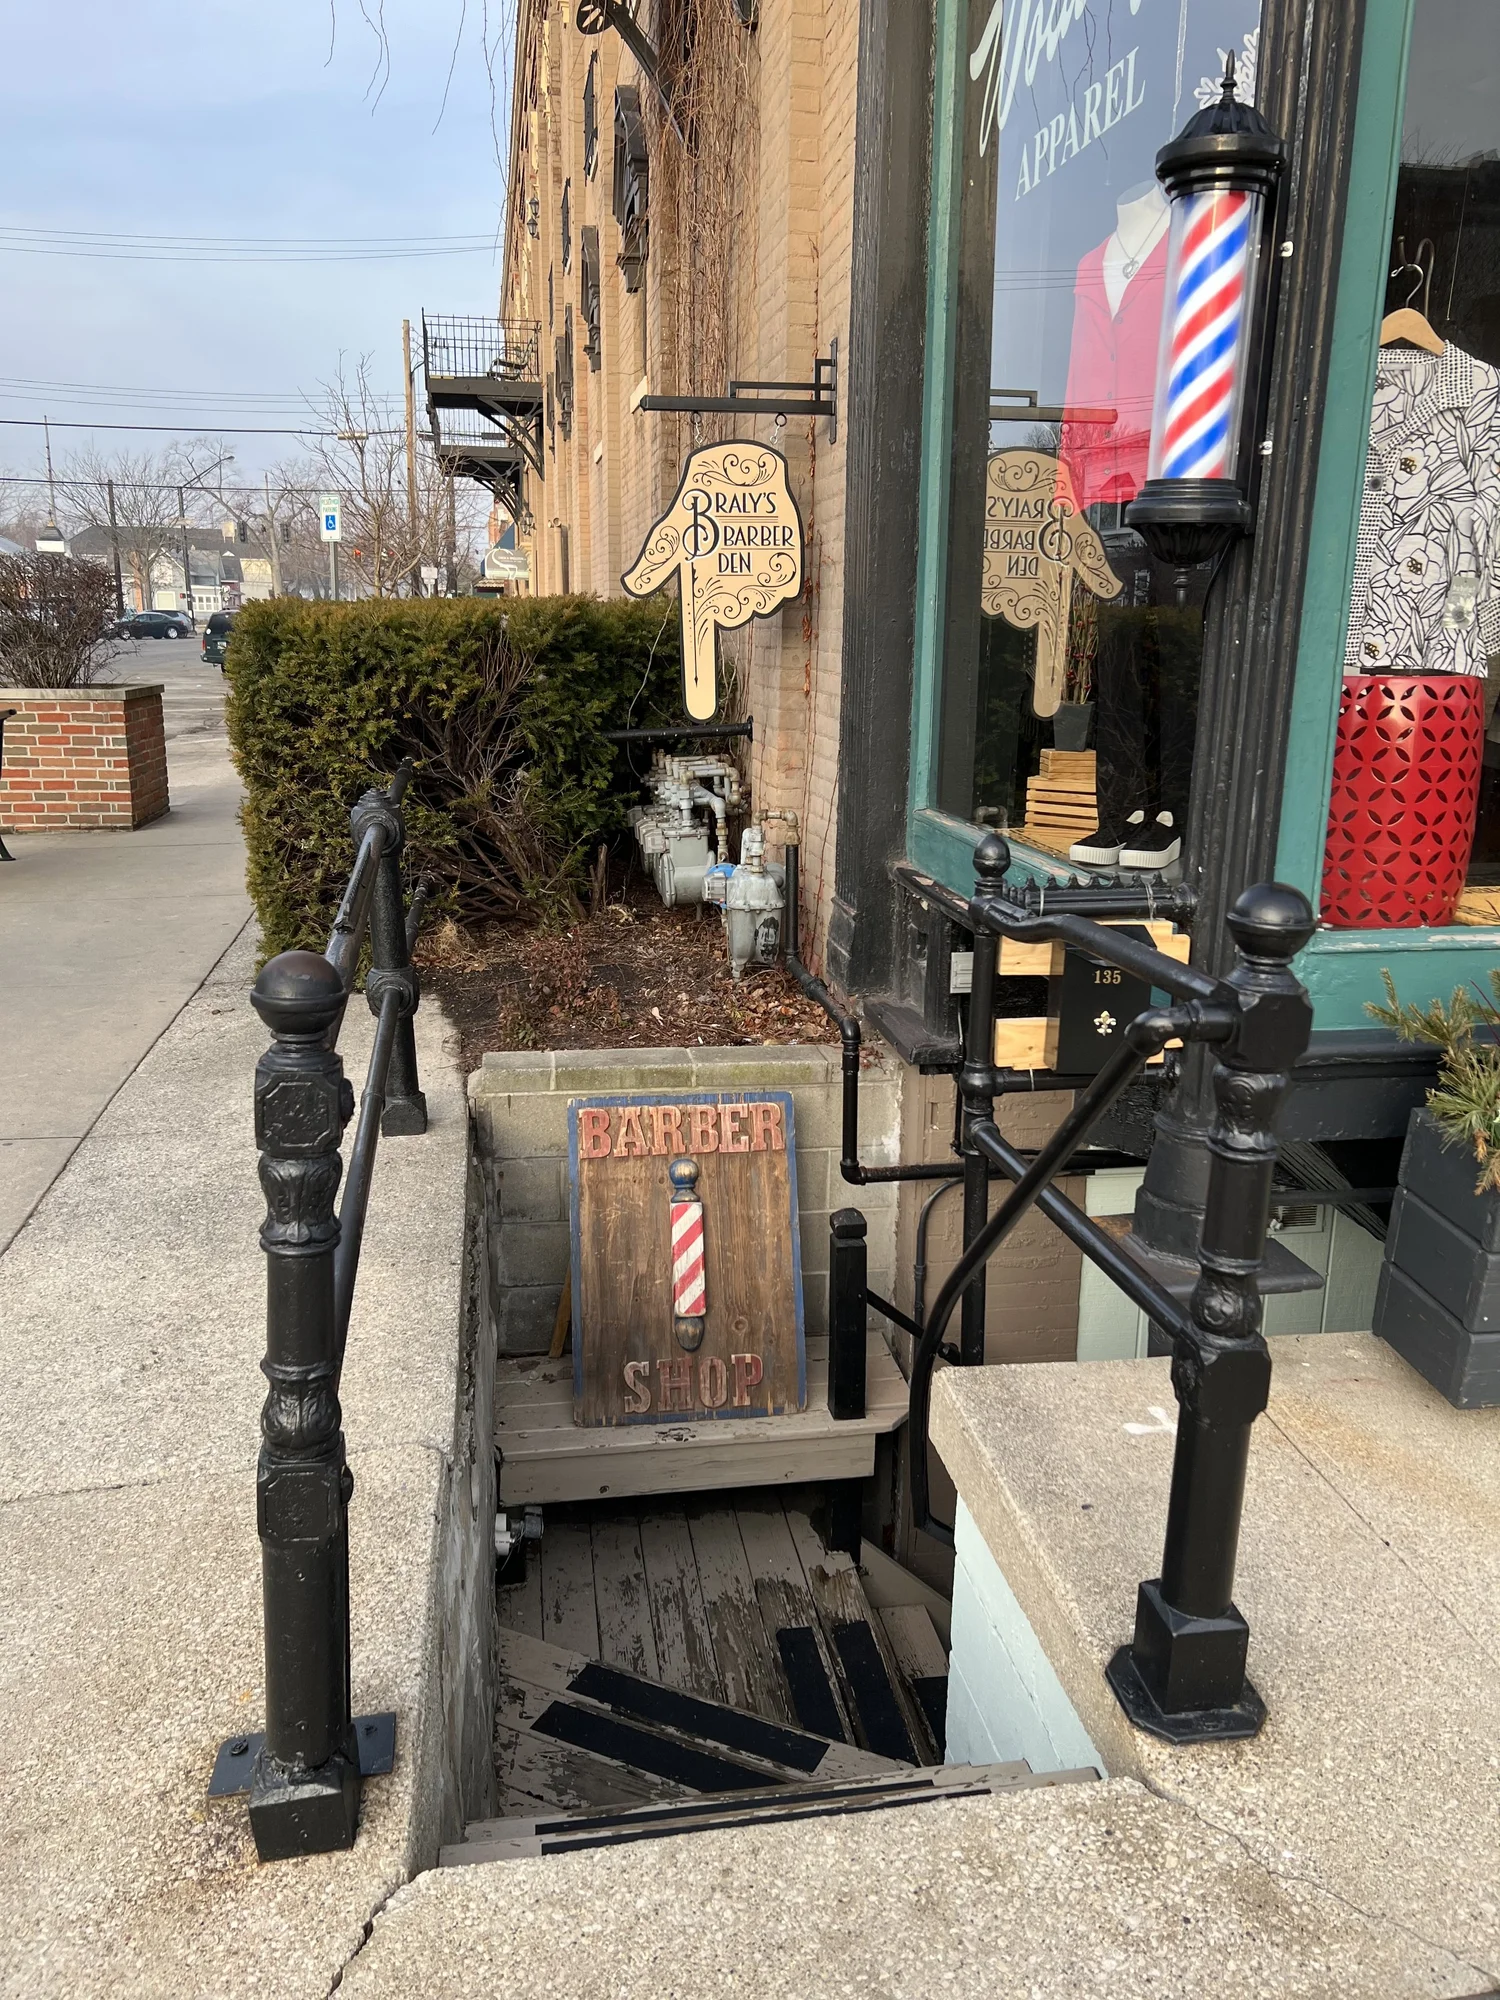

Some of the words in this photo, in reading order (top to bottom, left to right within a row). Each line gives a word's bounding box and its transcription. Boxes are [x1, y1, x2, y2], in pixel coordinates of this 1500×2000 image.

[1014, 46, 1146, 202] APPAREL
[723, 525, 796, 547] BARBER
[718, 552, 752, 574] DEN
[1093, 969, 1122, 985] 135
[578, 1102, 786, 1160] BARBER
[623, 1353, 764, 1415] SHOP
